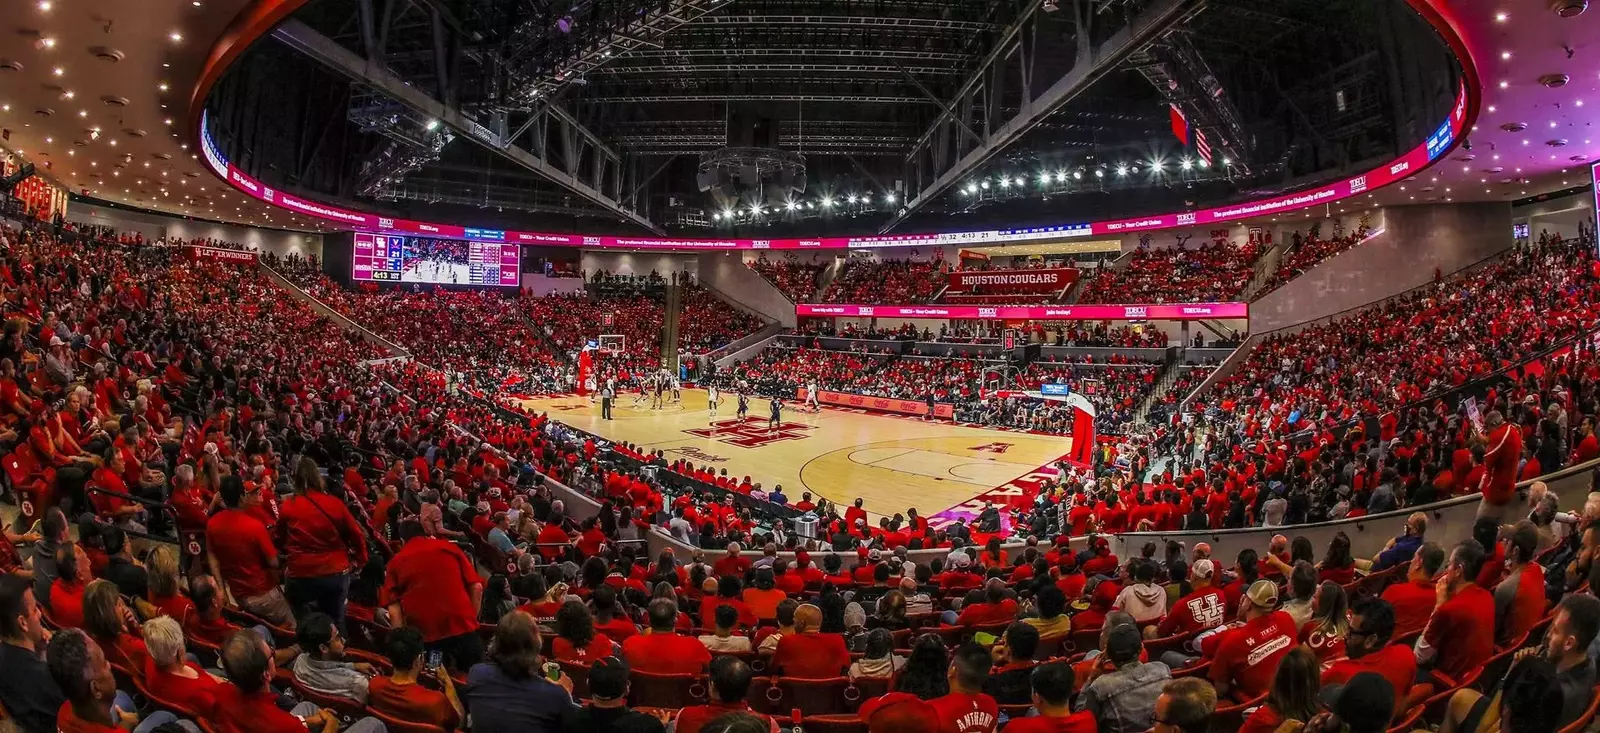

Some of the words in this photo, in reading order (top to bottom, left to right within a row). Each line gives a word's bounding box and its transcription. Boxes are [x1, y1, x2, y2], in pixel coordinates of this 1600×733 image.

[1350, 176, 1366, 187] TDECU
[203, 249, 252, 260] LETERWINNERS
[962, 275, 1009, 285] HOUSTON
[1009, 274, 1058, 283] COUGARS
[956, 711, 994, 732] ANTHONY
